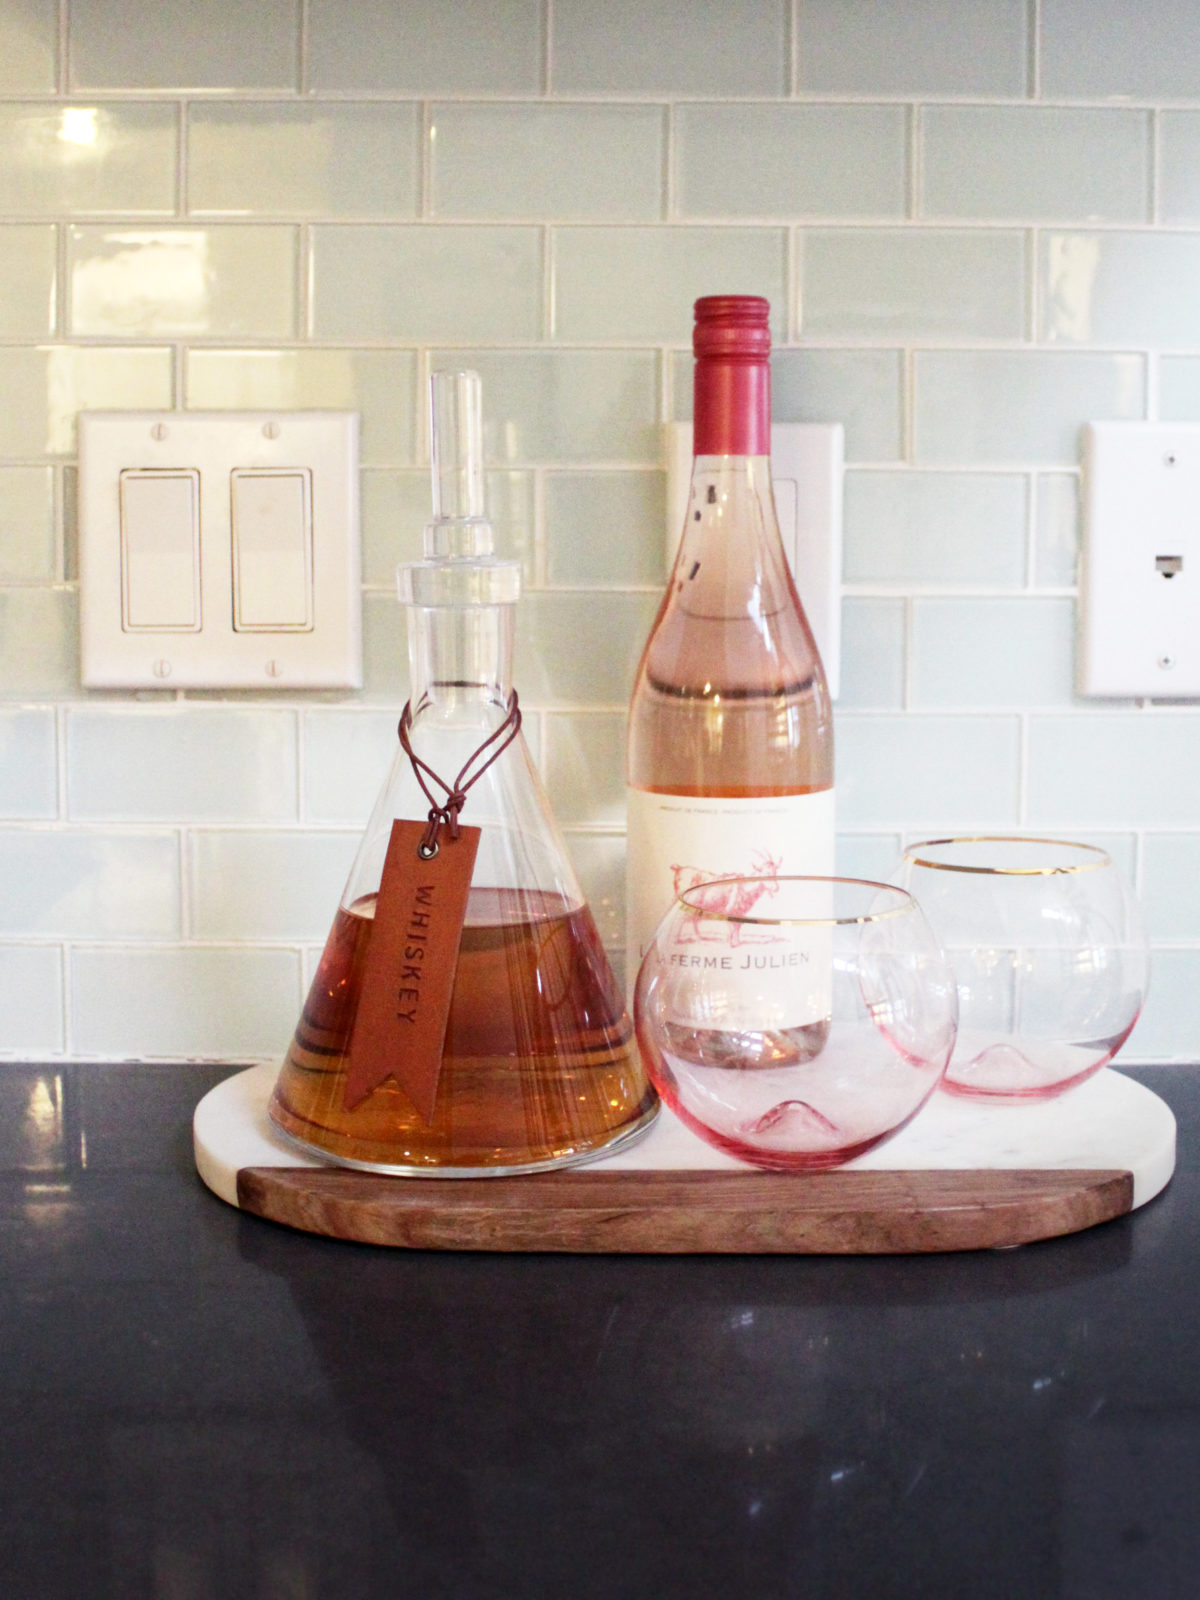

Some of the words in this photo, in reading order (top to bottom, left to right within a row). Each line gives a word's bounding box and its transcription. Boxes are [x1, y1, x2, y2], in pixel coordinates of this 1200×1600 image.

[397, 885, 435, 1024] WHISKEY
[670, 954, 733, 970] FERME
[740, 952, 810, 970] JULIEN
